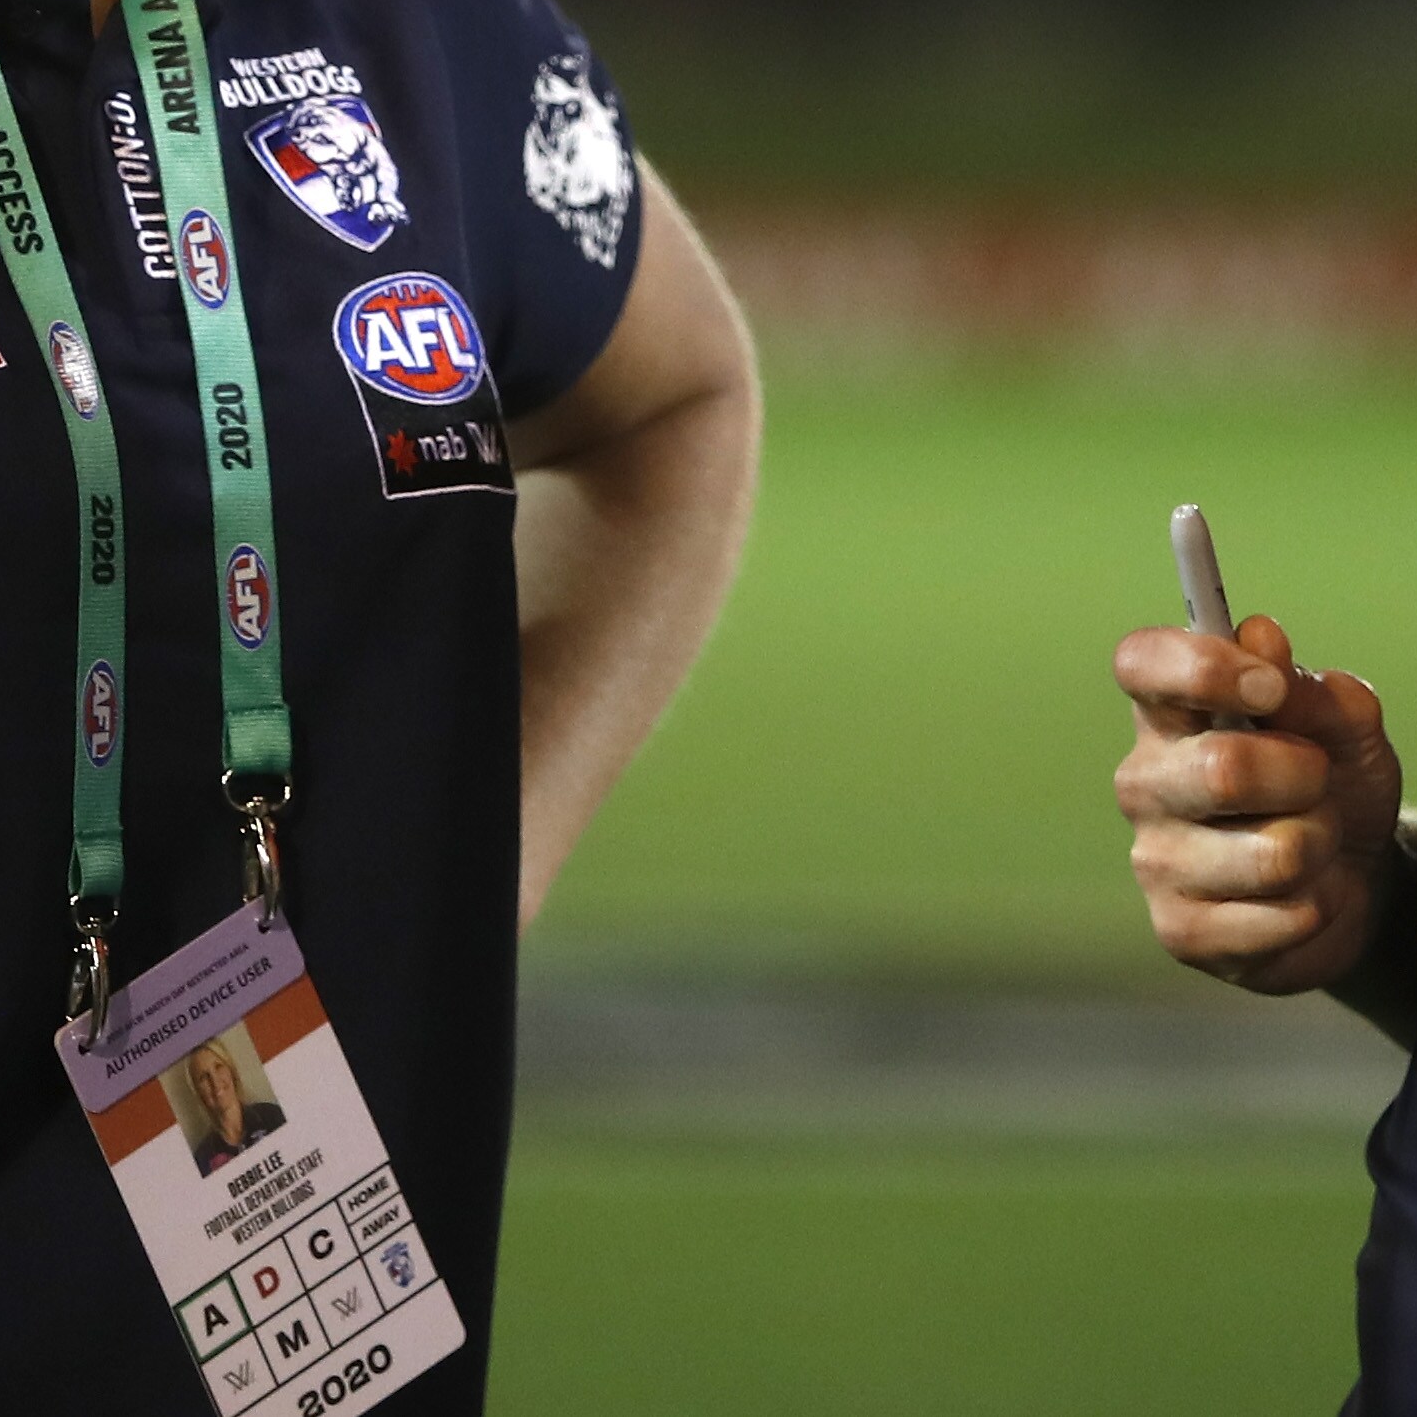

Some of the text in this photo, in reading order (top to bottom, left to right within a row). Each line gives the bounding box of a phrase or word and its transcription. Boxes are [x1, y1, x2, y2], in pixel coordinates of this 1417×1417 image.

[148, 19, 200, 134] ARENA
[219, 65, 363, 108] BULLDOGS
[229, 47, 327, 77] WESTERN
[104, 91, 178, 279] COTTON:O
[187, 217, 224, 302] AFL
[360, 307, 476, 371] AFL
[213, 383, 252, 470] 2020
[418, 425, 467, 461] nab
[90, 495, 116, 585] 2020
[233, 553, 262, 640] AFL
[91, 671, 113, 759] AFL
[187, 957, 228, 988] RESTRICTED
[229, 943, 250, 959] AREA
[106, 956, 273, 1078] AUTHORISED DEVICE USER
[203, 1148, 324, 1240] FOOTBALL DEPARTMENT STAFF
[227, 1150, 285, 1199] DEBBIE LEE
[347, 1176, 389, 1211] HOME
[231, 1180, 315, 1245] WESTERN BULLDOGS
[362, 1205, 400, 1240] AWAY
[203, 1229, 334, 1337] A D C
[275, 1319, 311, 1359] M
[298, 1344, 393, 1417] 2020
